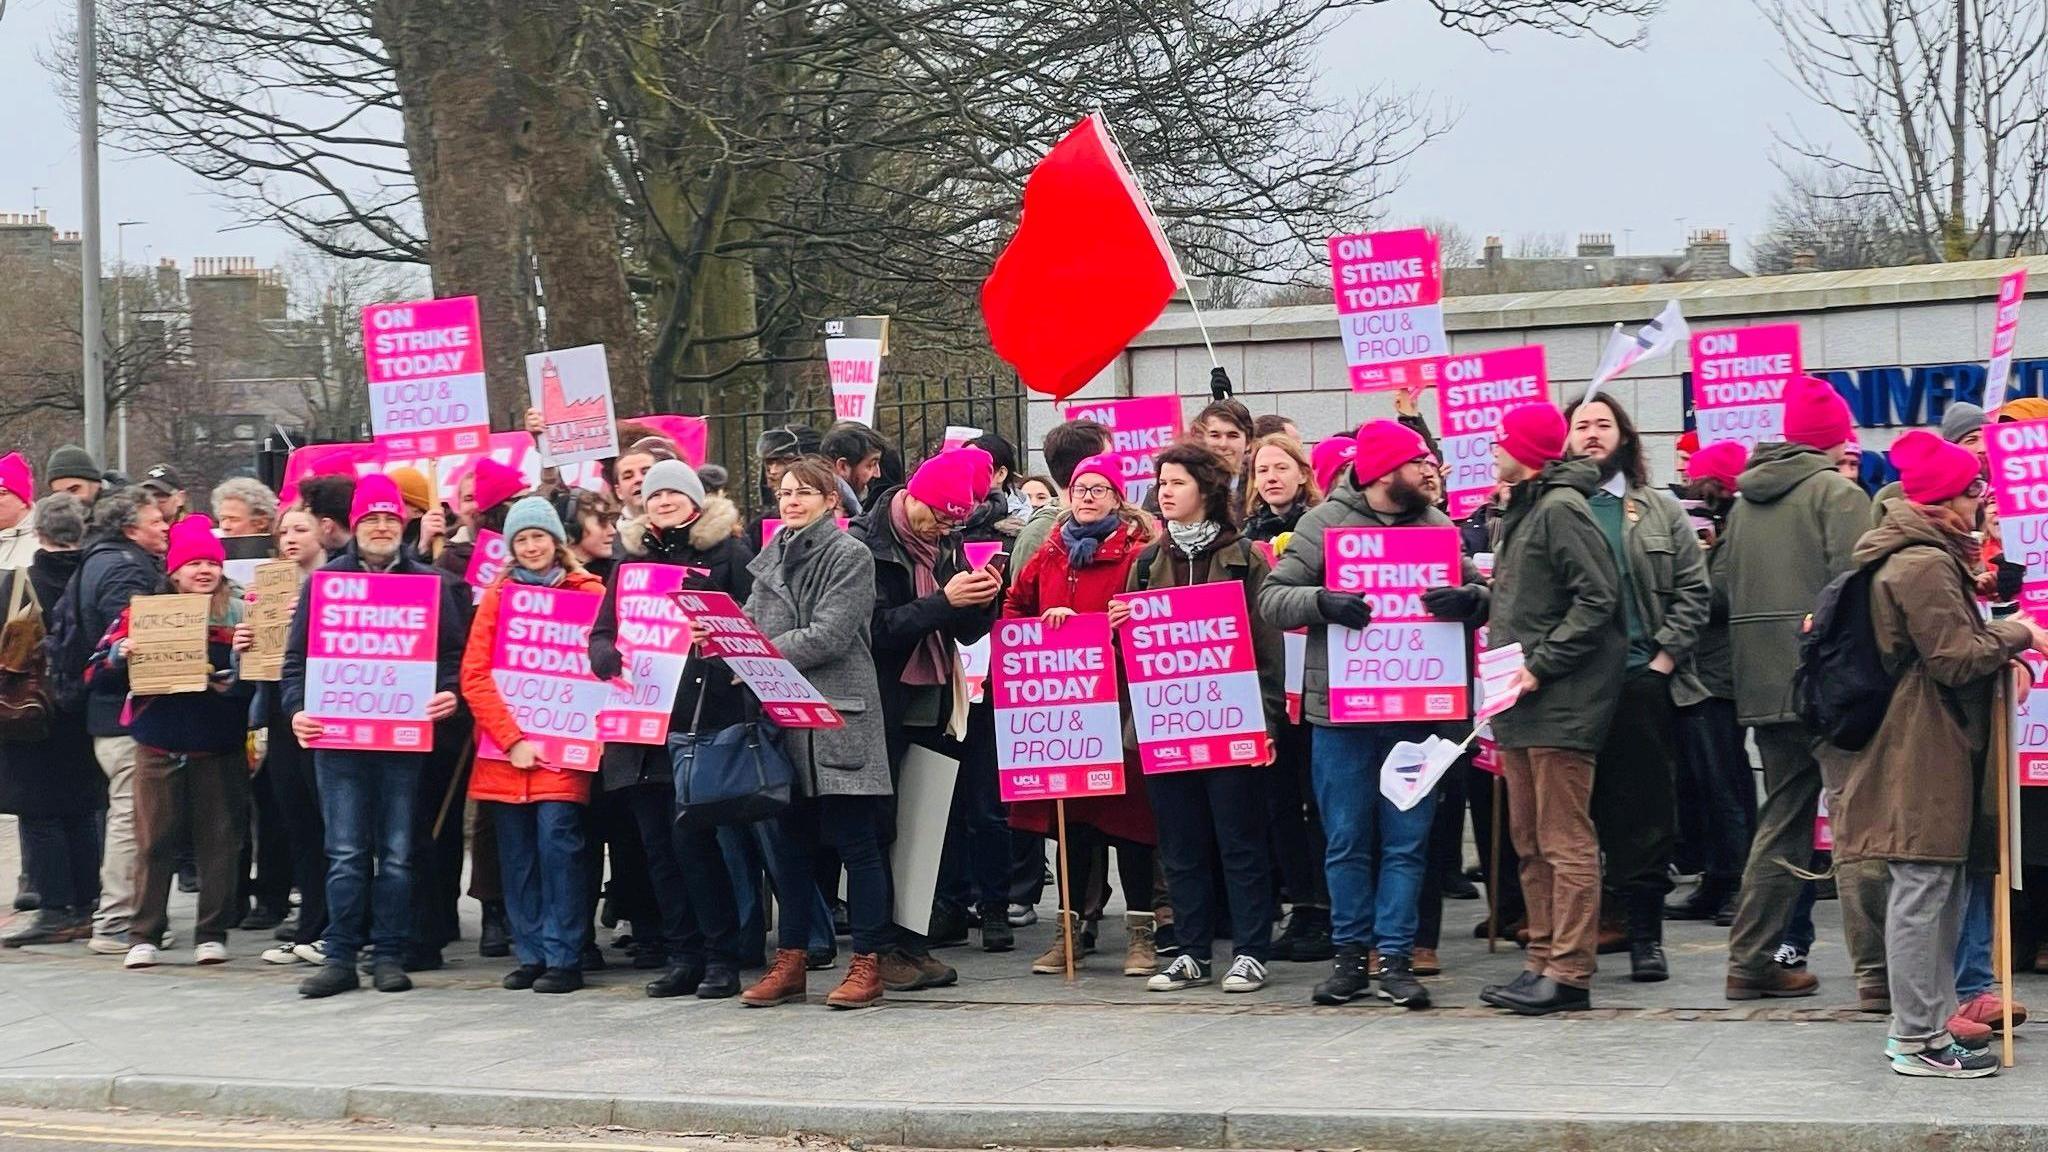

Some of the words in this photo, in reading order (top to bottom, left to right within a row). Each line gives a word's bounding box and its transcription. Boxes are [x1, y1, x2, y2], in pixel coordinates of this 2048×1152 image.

[1338, 238, 1373, 260] ON
[1341, 258, 1424, 286] STRIKE
[1344, 283, 1422, 309] TODAY
[373, 308, 415, 330] ON
[1353, 315, 1396, 336] UCU
[1400, 313, 1412, 330] &
[376, 325, 471, 354] STRIKE
[1358, 335, 1431, 360] PROUD
[1700, 333, 1737, 355] ON
[377, 351, 465, 377] TODAY
[830, 360, 873, 384] FFICIAL
[1445, 357, 1483, 382] ON
[1701, 354, 1793, 380] STRIKE
[384, 382, 435, 405] UCU
[438, 381, 452, 399] &
[1448, 375, 1540, 407] STRIKE
[1703, 379, 1787, 404] TODAY
[385, 403, 470, 429] PROUD
[835, 394, 866, 417] CKET
[1077, 407, 1117, 428] ON
[1449, 404, 1514, 431] TOD
[1708, 407, 1755, 432] UCU
[1758, 409, 1772, 428] &
[1112, 426, 1174, 453] RIKE
[1456, 436, 1492, 459] UC
[1338, 534, 1384, 558] ON
[623, 568, 649, 590] ON
[1338, 563, 1449, 588] STRIKE
[322, 577, 368, 600] ON
[511, 590, 554, 615] ON
[677, 595, 710, 611] ON
[1128, 595, 1172, 621] ON
[1364, 594, 1434, 618] ODA
[322, 605, 426, 629] STRIKE
[695, 615, 758, 636] STRIKE
[320, 632, 418, 656] TODAY
[508, 618, 591, 648] STRIK
[630, 620, 680, 648] DAY
[1001, 623, 1043, 647] ON
[1132, 617, 1239, 649] STRIKE
[1344, 629, 1402, 652] UCU
[1408, 629, 1425, 651] &
[712, 636, 771, 655] TODAY
[641, 656, 653, 677] &
[735, 660, 773, 677] UCU
[768, 662, 784, 677] &
[1003, 647, 1104, 675] STRIKE
[1136, 645, 1234, 677] TODAY
[1344, 658, 1444, 682] PROUD
[321, 663, 379, 686] UCU
[381, 666, 397, 686] &
[503, 676, 555, 701] UCU
[559, 683, 573, 704] &
[755, 681, 810, 698] PROUD
[1004, 676, 1099, 703] TODAY
[1147, 682, 1200, 707] UCU
[1207, 680, 1222, 702] &
[319, 691, 415, 715] PROUD
[1010, 711, 1064, 734] UCU
[1069, 710, 1083, 730] &
[1151, 707, 1243, 736] PROUD
[1012, 738, 1102, 763] PROUD
[1091, 773, 1110, 781] UCU
